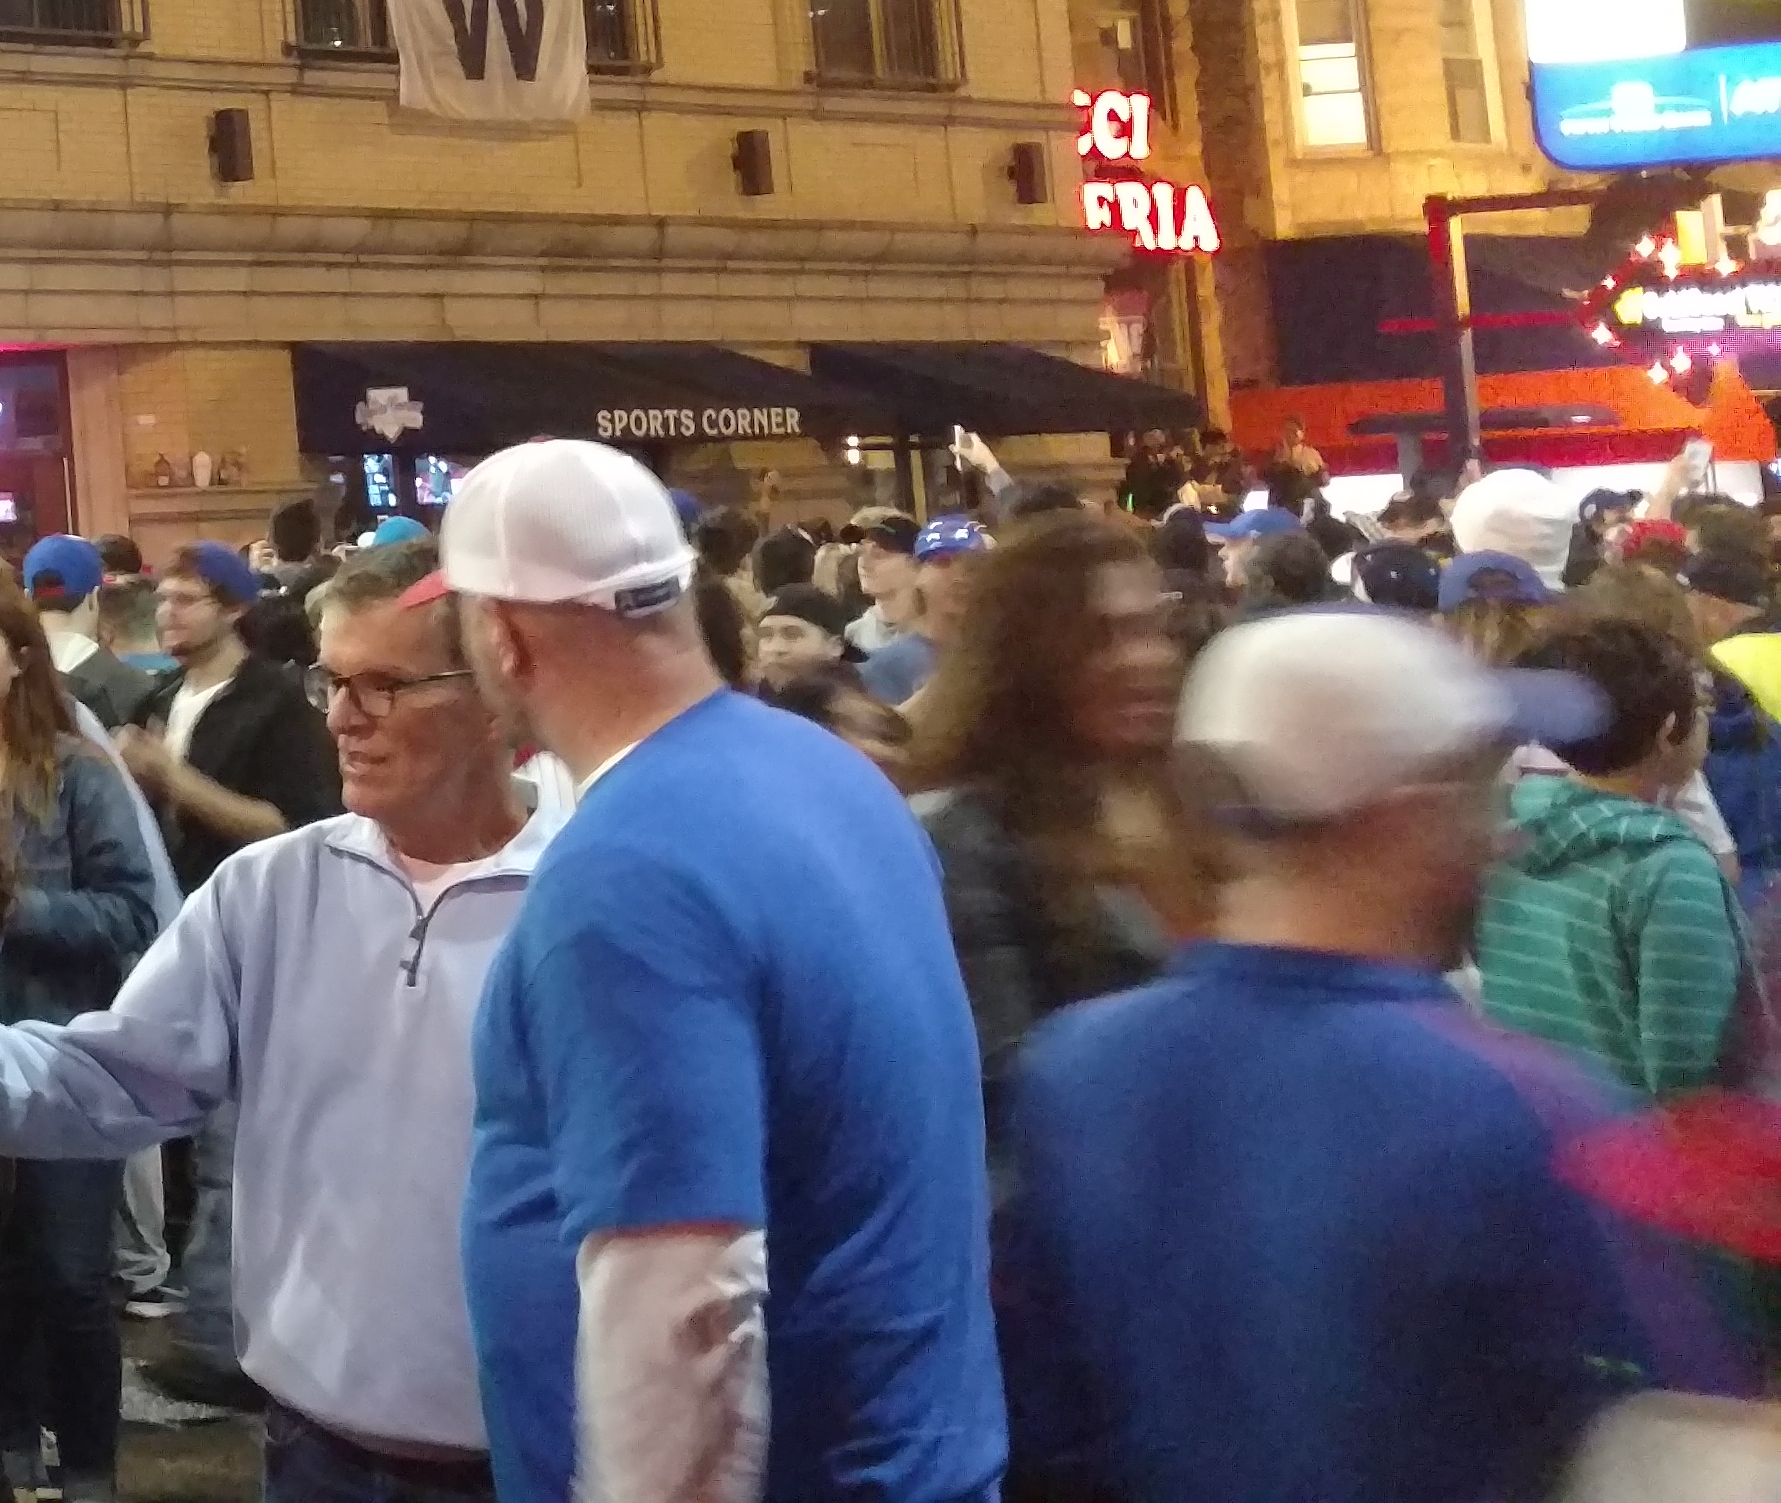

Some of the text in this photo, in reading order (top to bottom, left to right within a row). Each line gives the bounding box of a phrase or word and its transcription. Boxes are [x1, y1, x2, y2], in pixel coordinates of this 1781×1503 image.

[1072, 89, 1151, 160] CI
[597, 407, 801, 438] SPORTS CORNER
